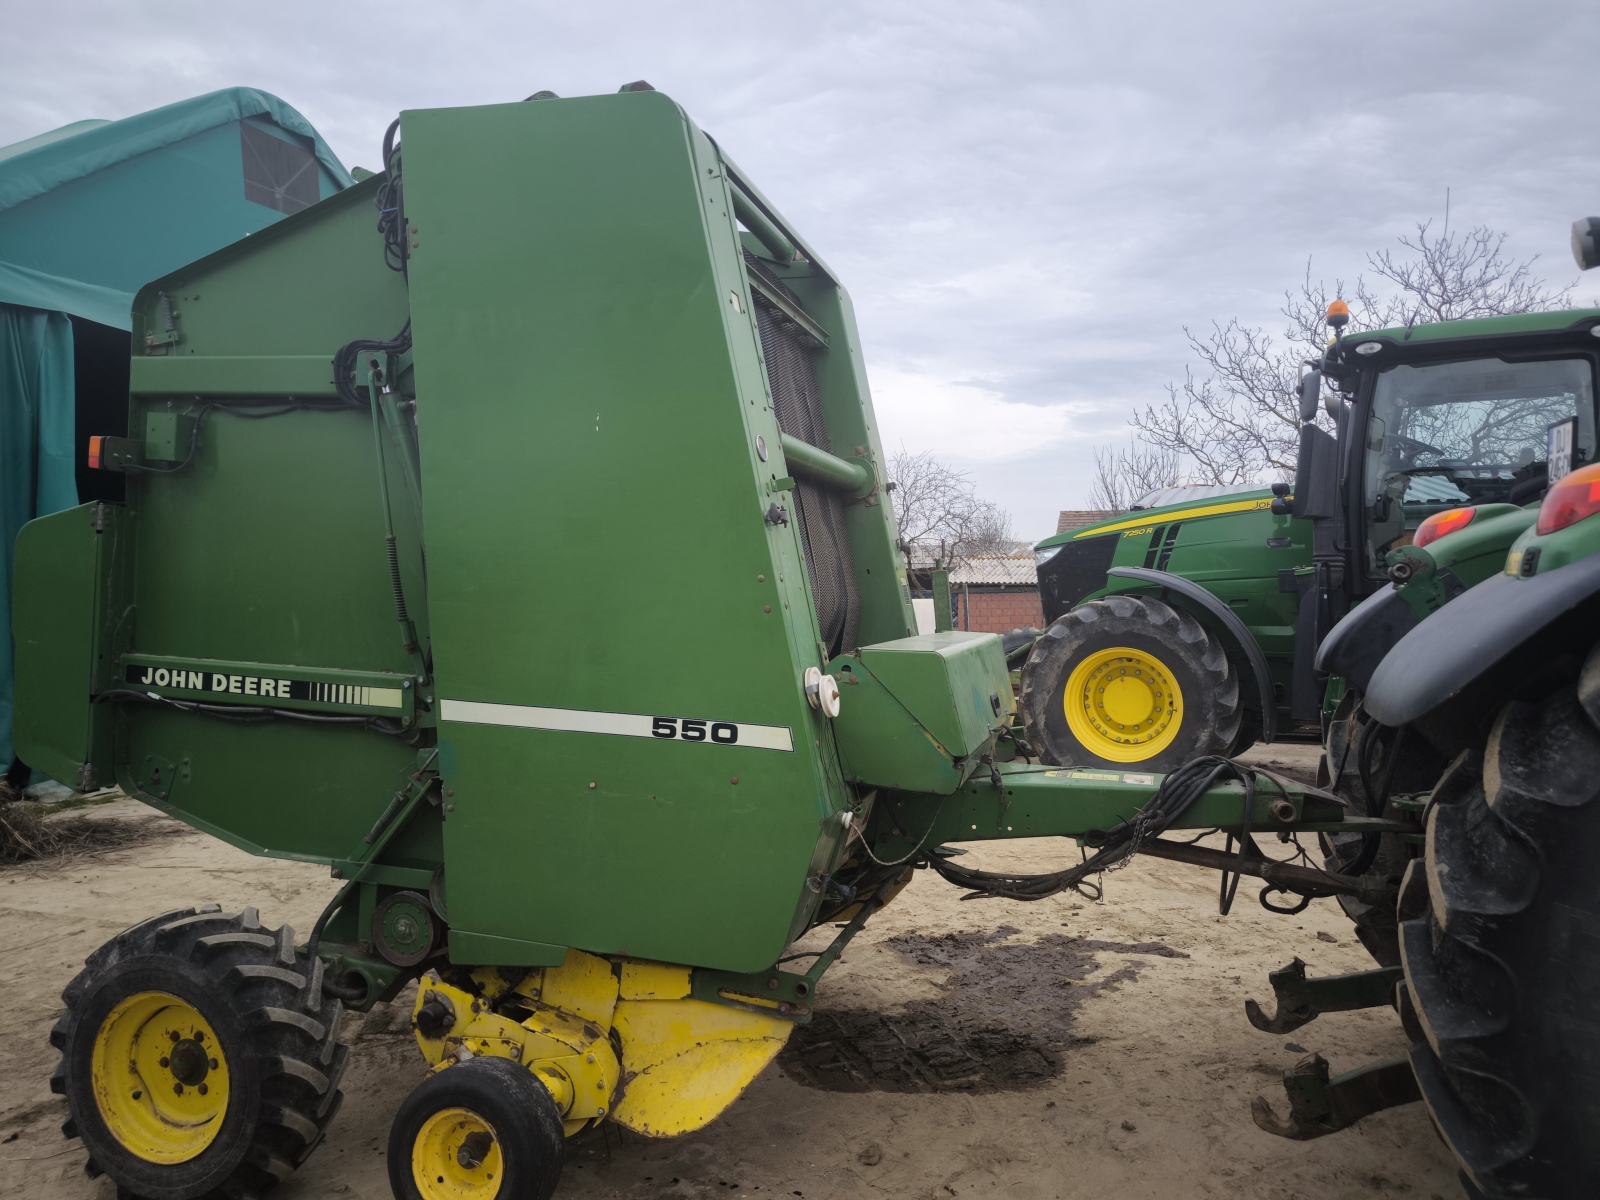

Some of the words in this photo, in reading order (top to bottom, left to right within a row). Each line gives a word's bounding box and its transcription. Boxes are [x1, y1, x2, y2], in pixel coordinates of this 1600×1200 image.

[1256, 500, 1272, 509] JOH
[1123, 528, 1146, 538] 7250
[141, 667, 203, 690] JOHN
[211, 673, 291, 698] DEERE
[651, 716, 739, 744] 550
